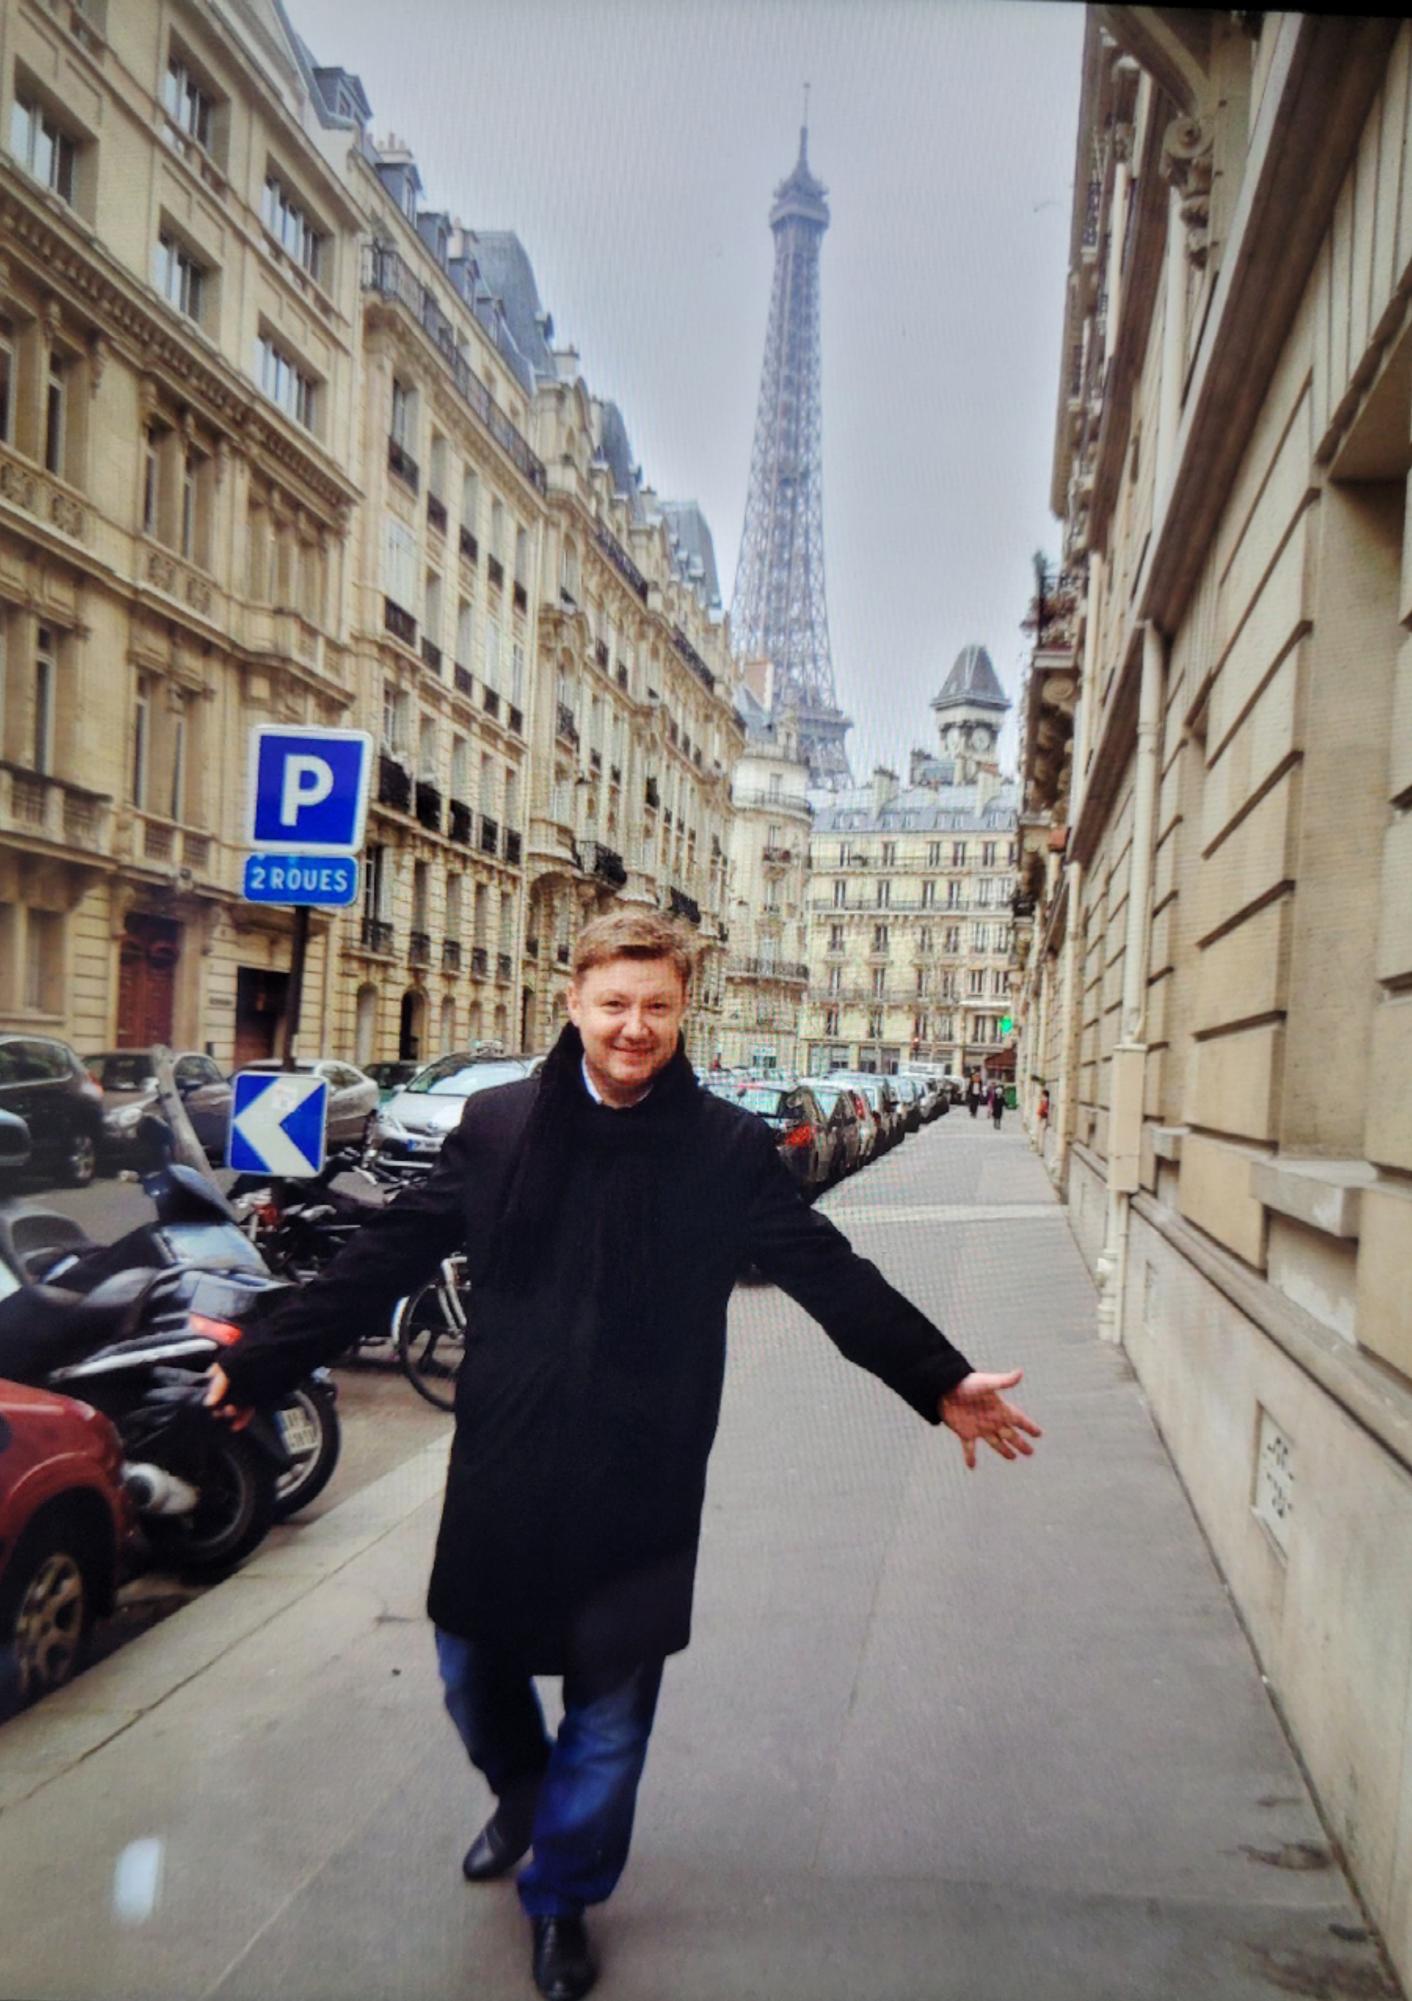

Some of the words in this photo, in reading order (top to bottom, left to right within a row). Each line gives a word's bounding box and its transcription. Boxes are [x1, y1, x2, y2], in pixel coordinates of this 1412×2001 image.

[280, 754, 334, 826] P
[251, 867, 265, 890] 2
[270, 868, 348, 892] ROUES
